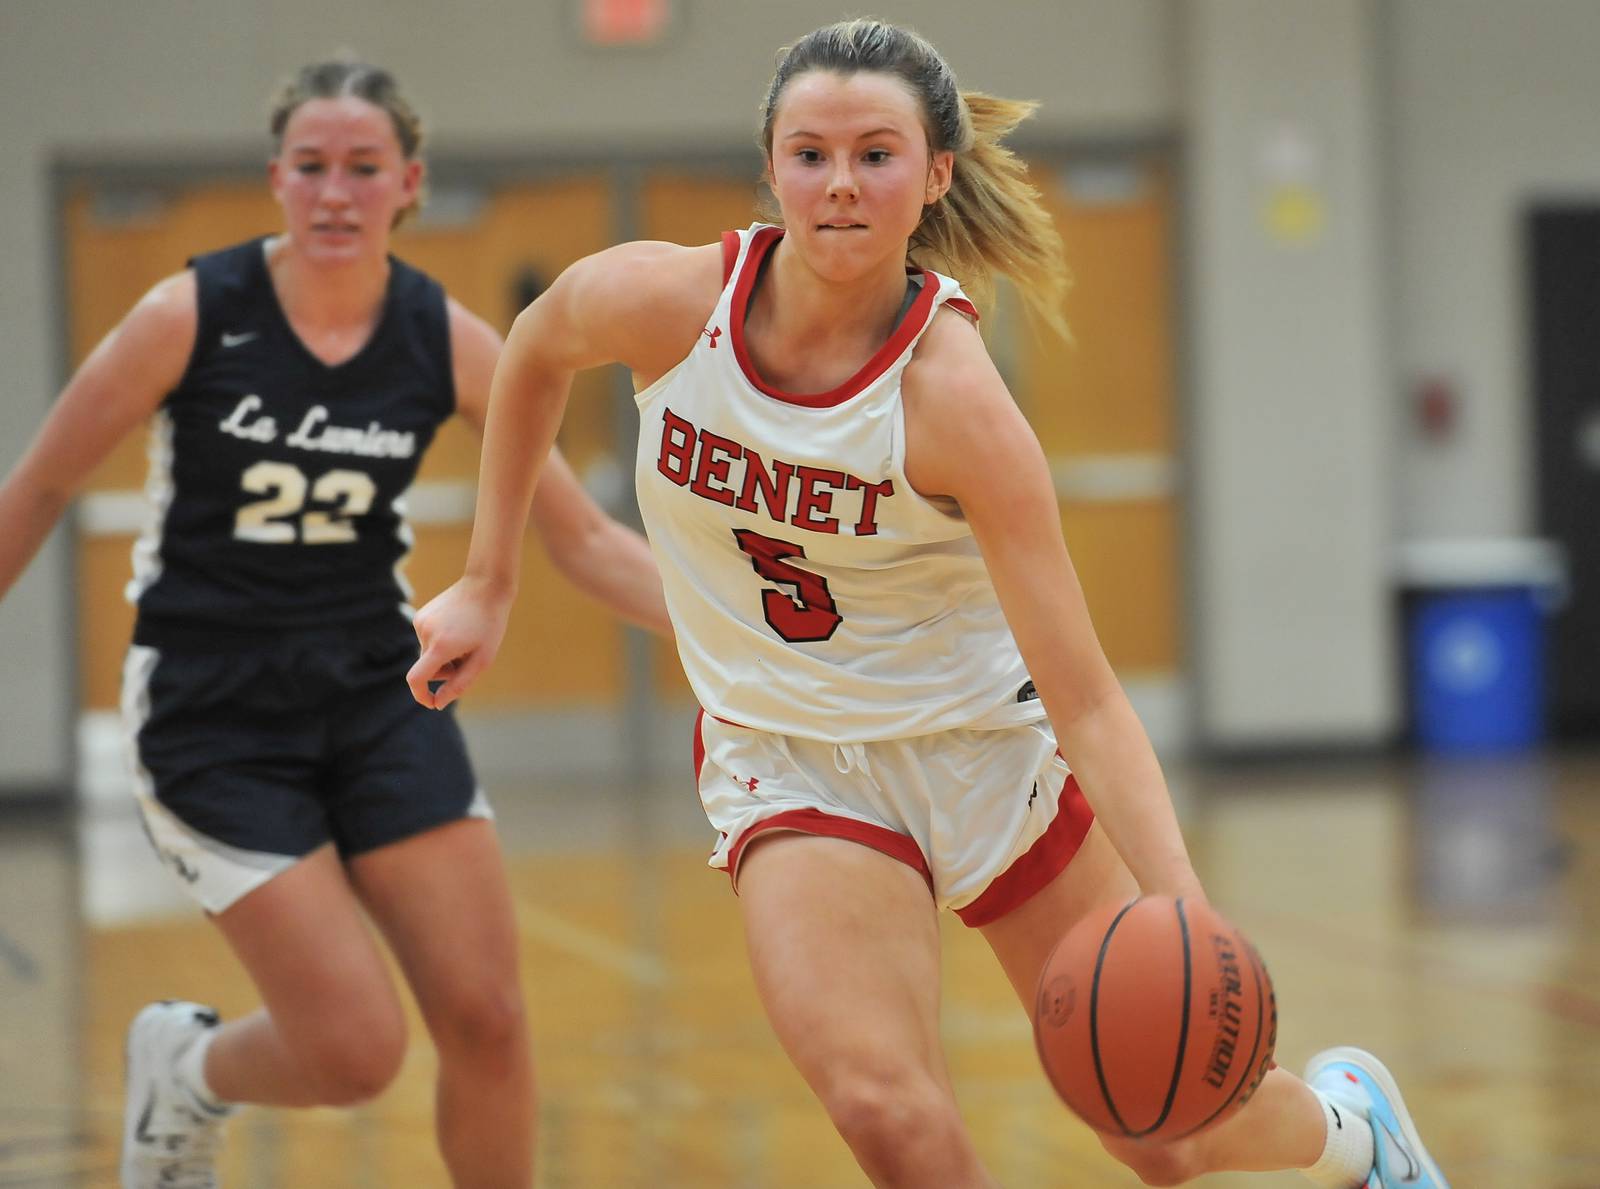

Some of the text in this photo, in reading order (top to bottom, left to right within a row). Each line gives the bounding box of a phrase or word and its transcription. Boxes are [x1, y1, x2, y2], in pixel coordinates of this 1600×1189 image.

[219, 394, 278, 443] La
[232, 460, 377, 545] 22
[657, 406, 895, 536] BENET
[731, 528, 843, 643] 5
